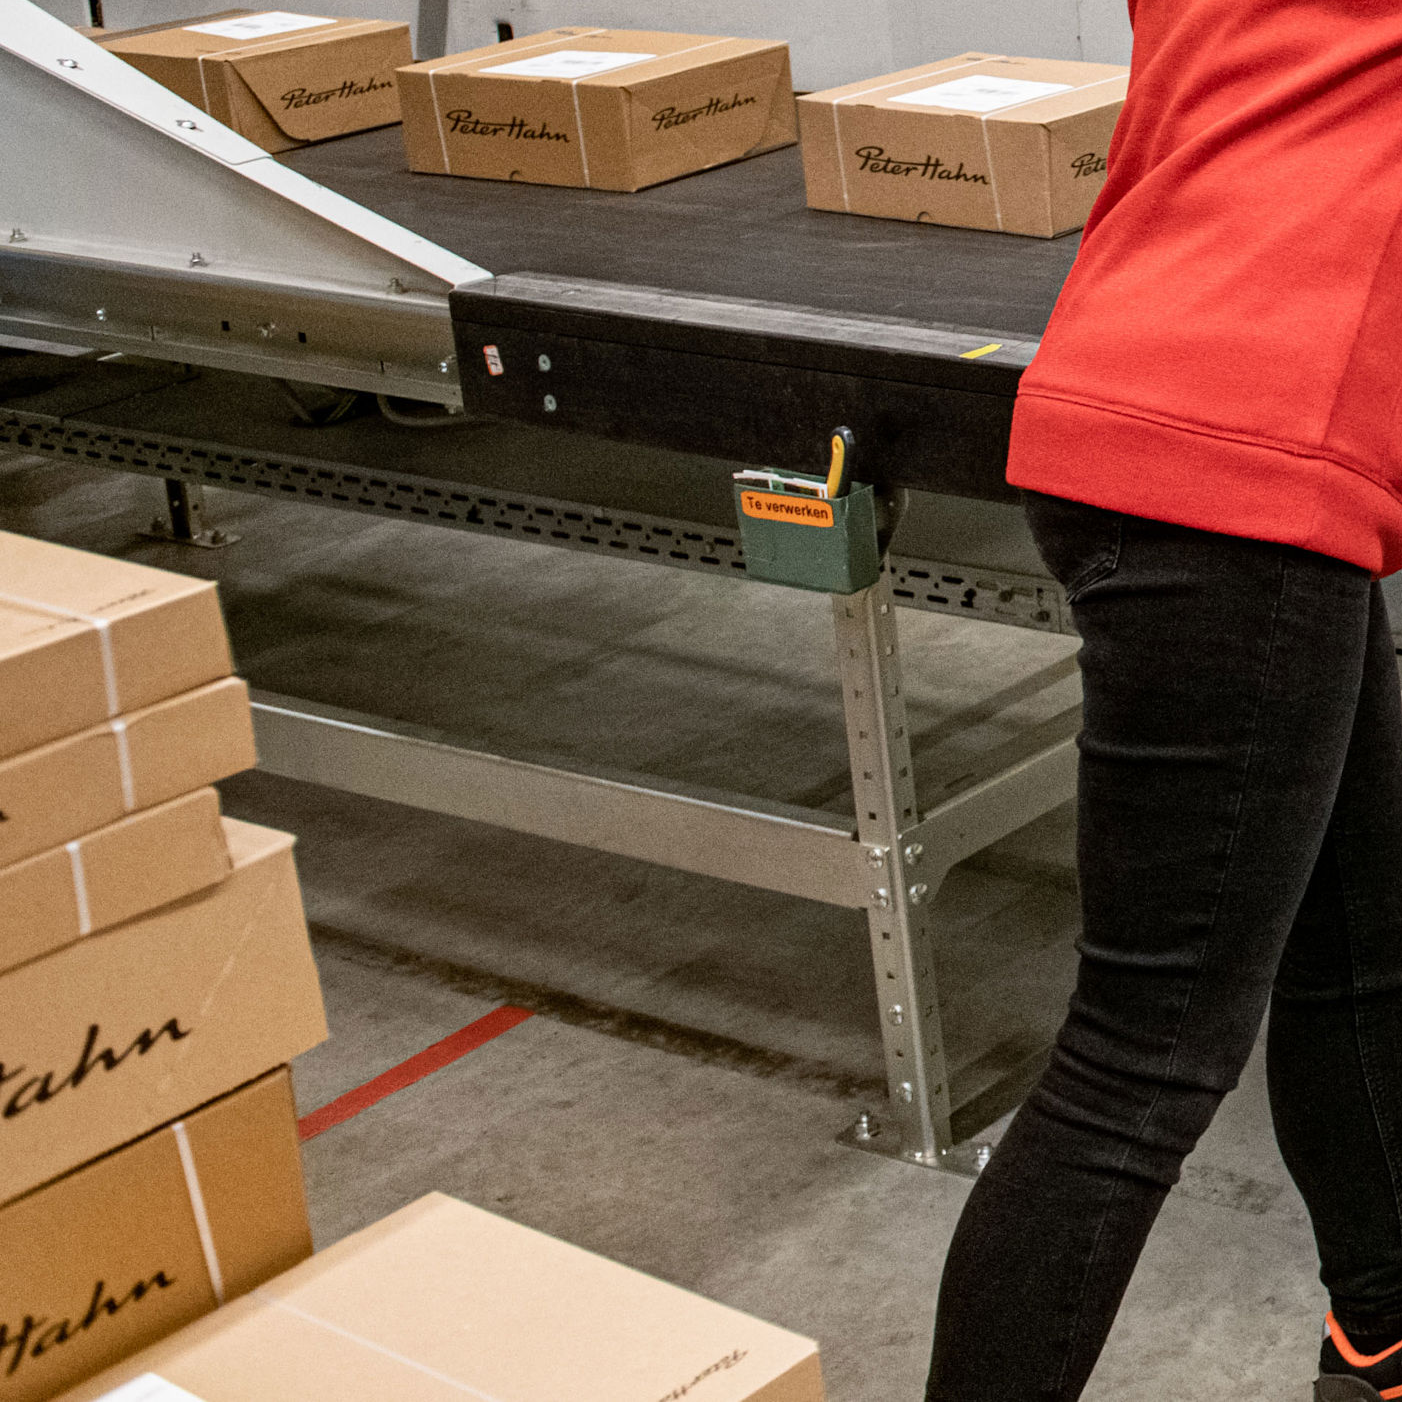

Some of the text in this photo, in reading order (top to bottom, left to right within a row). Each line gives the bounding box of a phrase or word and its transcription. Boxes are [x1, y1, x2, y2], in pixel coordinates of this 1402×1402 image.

[747, 496, 829, 520] Te verwerken
[0, 1017, 193, 1119] ahn
